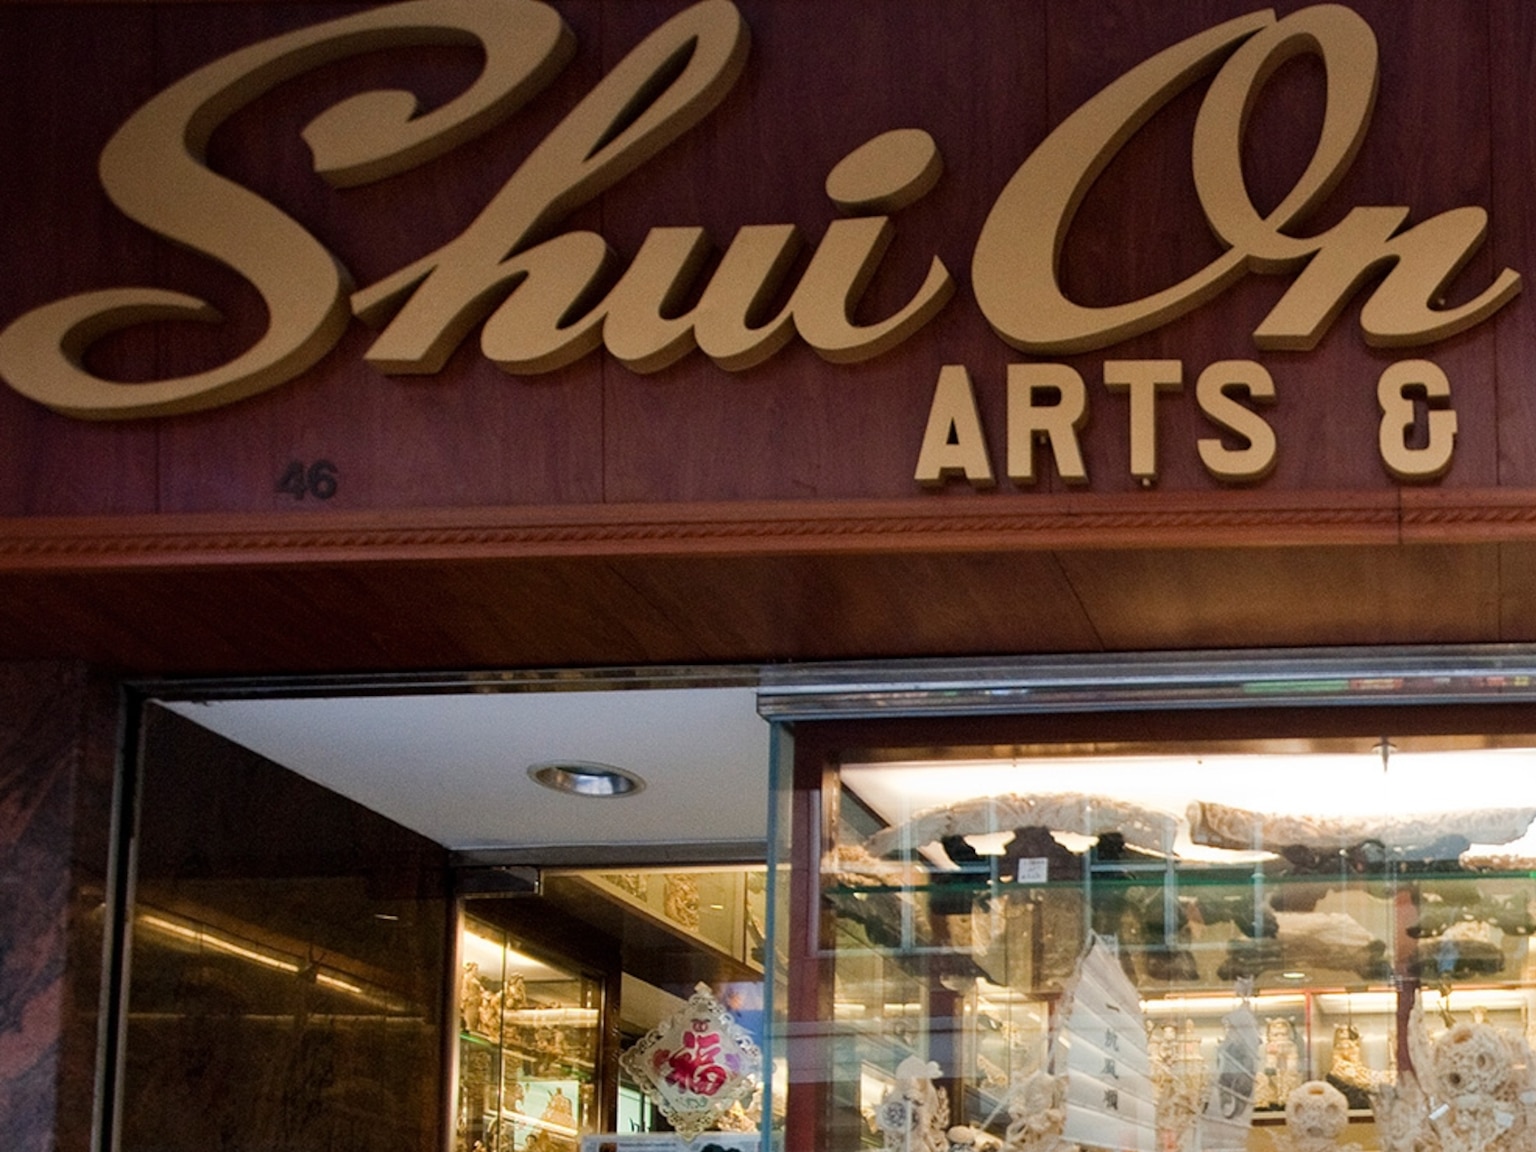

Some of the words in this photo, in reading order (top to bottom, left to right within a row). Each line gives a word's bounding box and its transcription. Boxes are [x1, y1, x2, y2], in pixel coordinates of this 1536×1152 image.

[0, 0, 956, 421] Shui
[971, 3, 1522, 354] On
[914, 360, 1279, 488] ARTS
[1376, 359, 1459, 481] &
[275, 460, 339, 501] 46
[665, 1030, 729, 1097] 福
